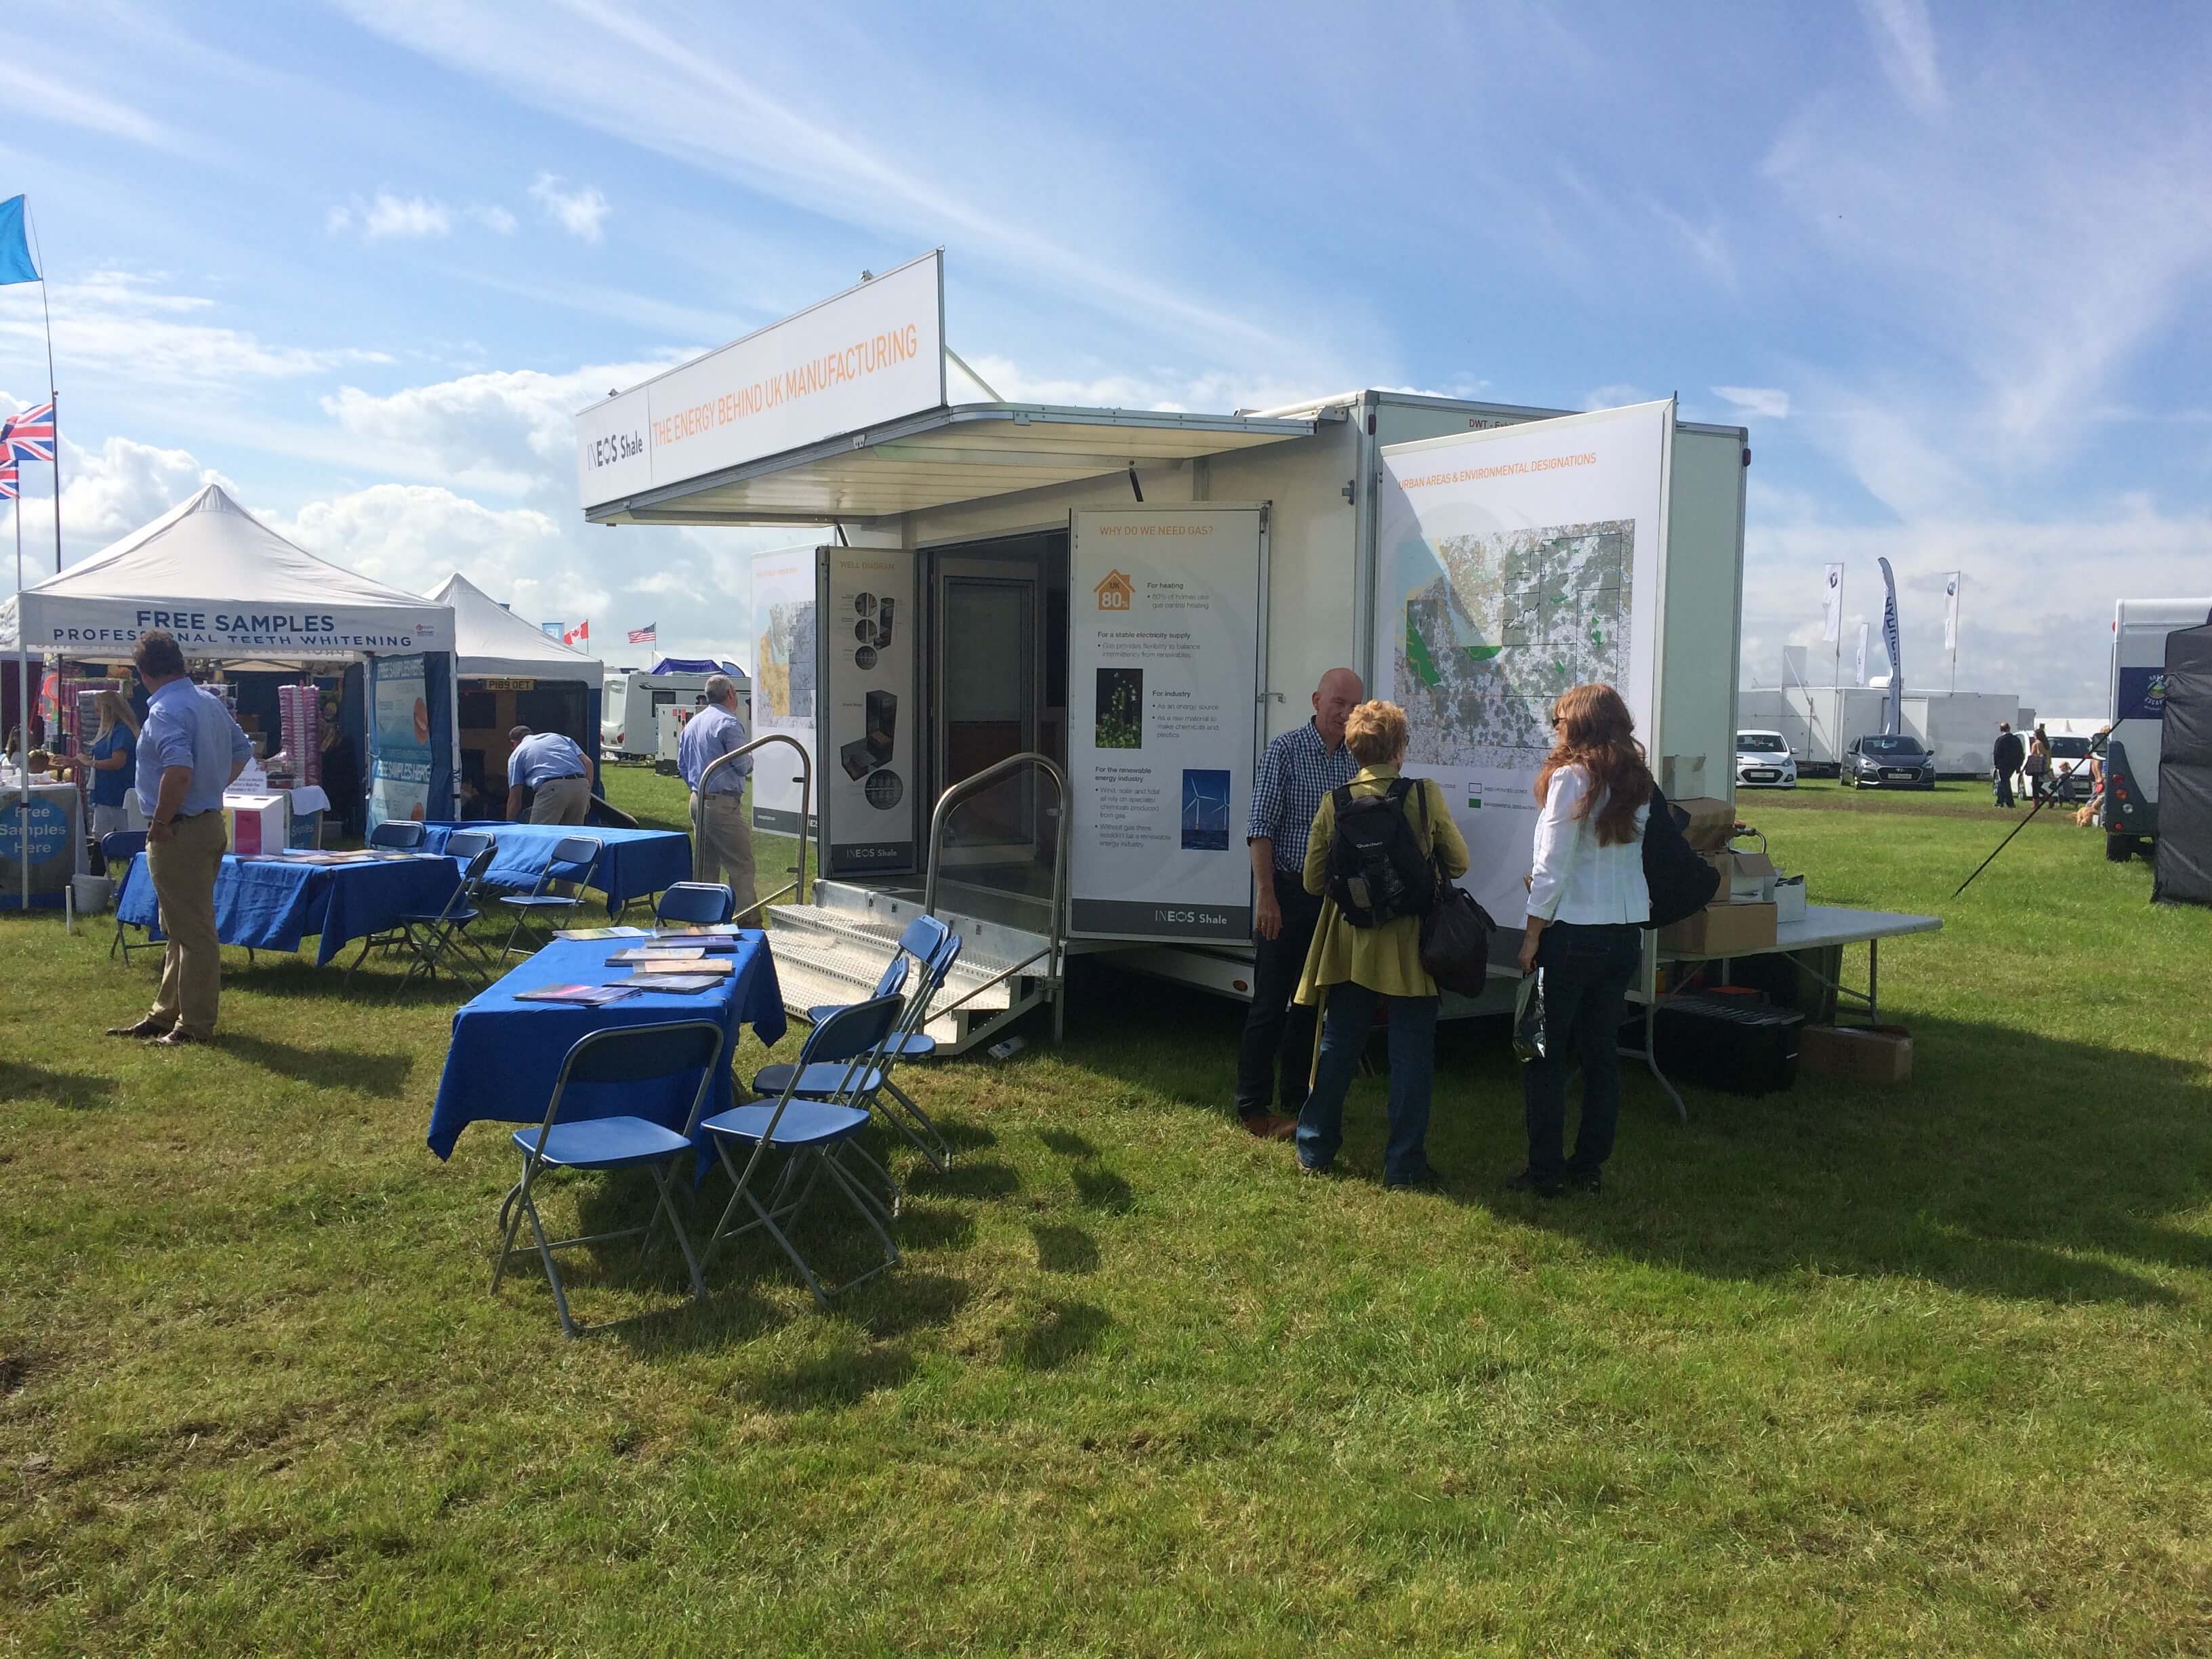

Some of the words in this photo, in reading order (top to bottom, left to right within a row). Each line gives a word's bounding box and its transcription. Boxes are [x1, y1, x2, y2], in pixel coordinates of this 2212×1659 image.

[653, 418, 672, 447] THE
[676, 401, 715, 441] ENERGY
[718, 384, 762, 426] BEHIND
[766, 374, 783, 407] UK
[786, 324, 917, 402] MANUFACTURING
[1469, 419, 1488, 428] DWT
[588, 434, 617, 471] INEOS
[621, 430, 643, 460] Shale
[1399, 477, 1425, 490] URBAN
[1426, 473, 1451, 487] AREAS
[1452, 472, 1458, 483] &
[1460, 462, 1529, 482] ENVIRONMENTAL
[1532, 453, 1596, 472] DESIGNATIONS
[1100, 526, 1121, 535] WHY
[1124, 526, 1138, 535] DO
[1139, 526, 1155, 535] WE
[1159, 526, 1185, 535] NEED
[1188, 526, 1213, 535] GAS?
[137, 611, 205, 630] FREE
[216, 615, 335, 632] SAMPLES
[54, 628, 218, 642] PROFESNAL
[228, 636, 290, 644] TEETH
[300, 636, 411, 646] WHITENING
[1136, 632, 1167, 640] electricity
[1169, 632, 1191, 640] supply
[1164, 690, 1191, 698] industry
[15, 806, 50, 818] Fee
[0, 824, 66, 838] Samples
[14, 842, 52, 853] Here
[847, 848, 875, 858] INEOS
[877, 849, 897, 857] Shale
[1155, 910, 1195, 922] INEOS
[1200, 913, 1227, 924] Shale
